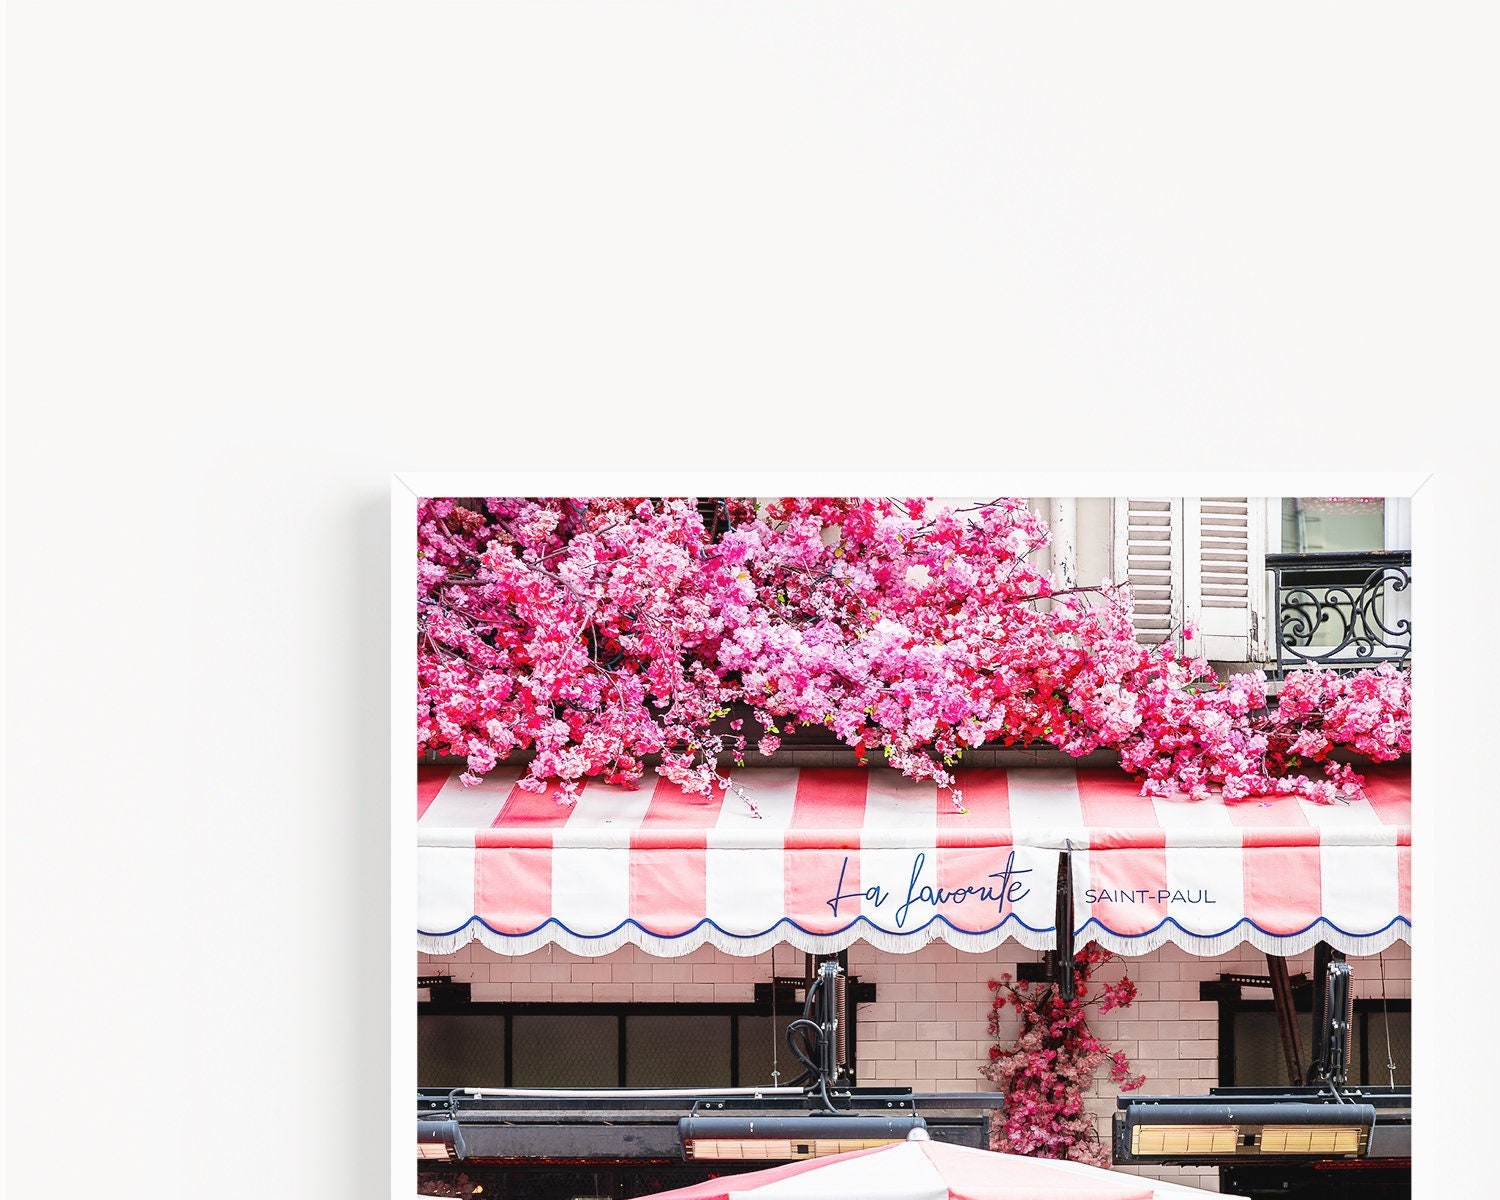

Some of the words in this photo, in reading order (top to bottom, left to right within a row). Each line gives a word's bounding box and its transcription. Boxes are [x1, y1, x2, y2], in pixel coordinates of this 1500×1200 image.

[826, 855, 889, 918] La
[895, 850, 1033, 928] favorite
[1084, 887, 1217, 904] SAINT-PAUL
